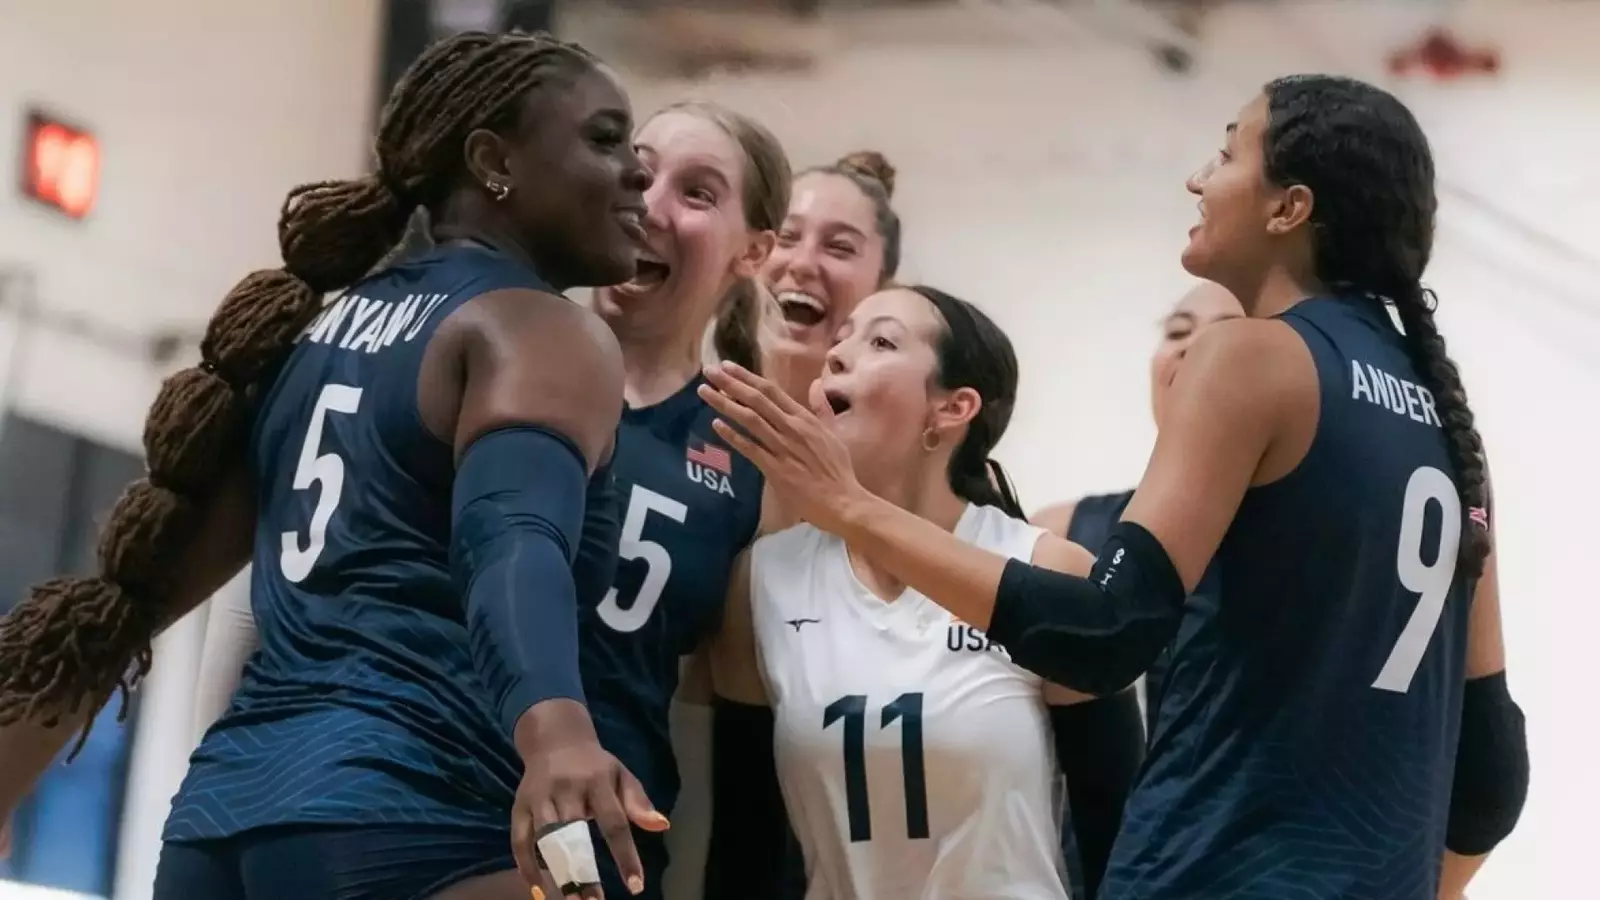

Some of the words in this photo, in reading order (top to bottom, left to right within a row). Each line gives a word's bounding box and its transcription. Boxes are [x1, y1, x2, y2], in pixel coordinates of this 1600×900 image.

[280, 384, 363, 583] 5
[686, 460, 735, 498] USA
[596, 484, 688, 632] 5
[1370, 465, 1461, 694] 9
[823, 692, 930, 842] 11
